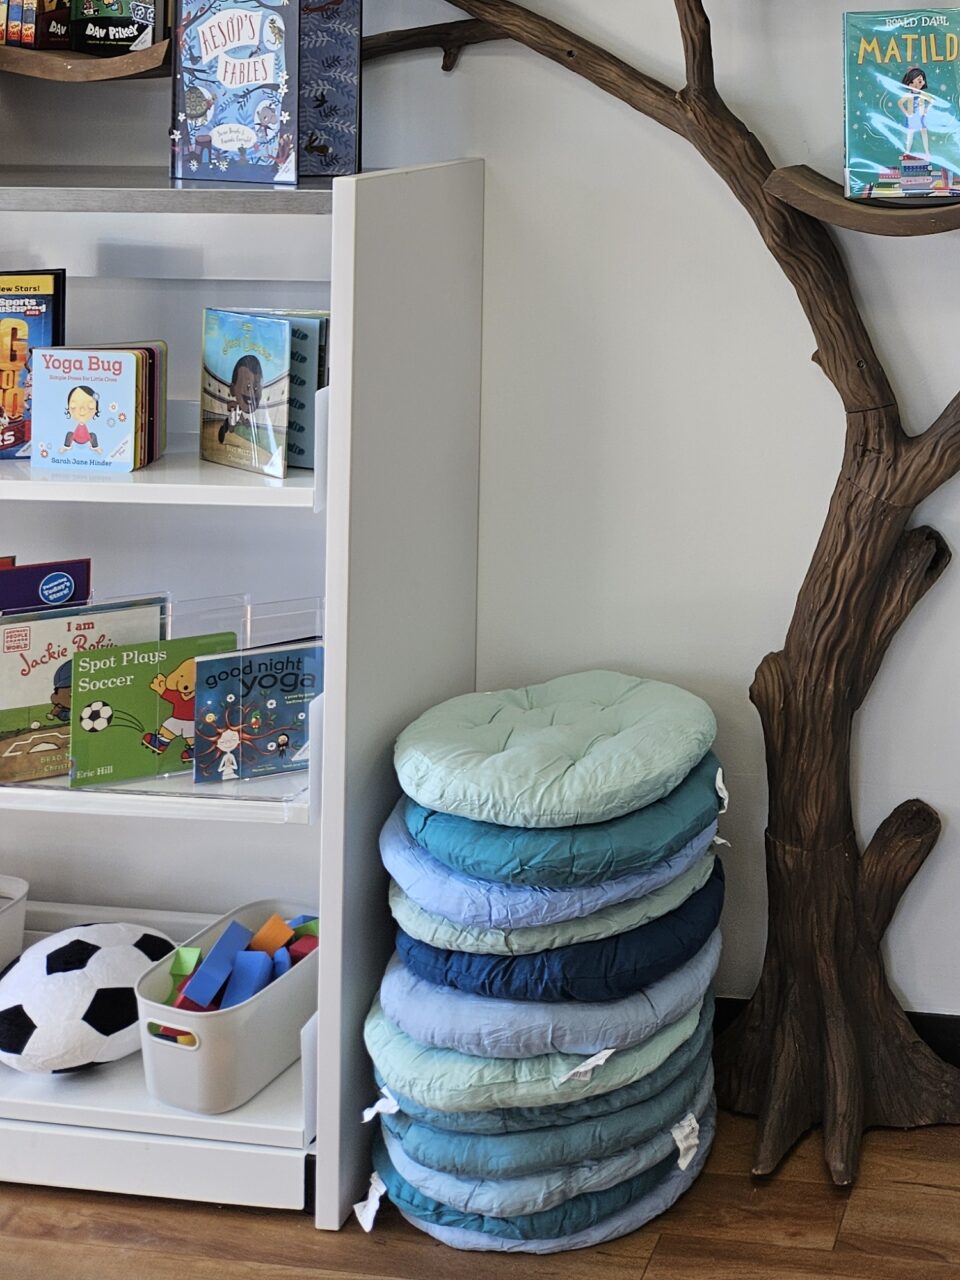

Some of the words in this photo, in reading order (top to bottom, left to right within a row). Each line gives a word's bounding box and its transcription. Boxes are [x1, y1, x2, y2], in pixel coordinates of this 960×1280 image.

[50, 21, 67, 35] DAV
[86, 23, 106, 38] DAV
[886, 18, 918, 28] ROALD
[922, 16, 950, 26] DAHL
[202, 13, 256, 55] AESOP'S
[223, 58, 268, 85] FABLES
[42, 354, 83, 373] Yoga
[88, 356, 122, 375] Bug
[51, 457, 71, 465] Sarah
[72, 458, 88, 466] Jane
[89, 459, 112, 467] Hinder
[67, 622, 71, 632] I
[75, 622, 94, 631] am
[20, 642, 67, 676] Jackie
[78, 656, 117, 673] Spot
[122, 649, 167, 668] Plays
[205, 661, 253, 689] good
[258, 656, 303, 674] night
[78, 674, 134, 693] Soccer
[239, 673, 315, 698] yoga
[76, 768, 95, 779] Eric
[97, 766, 113, 777] Hill
